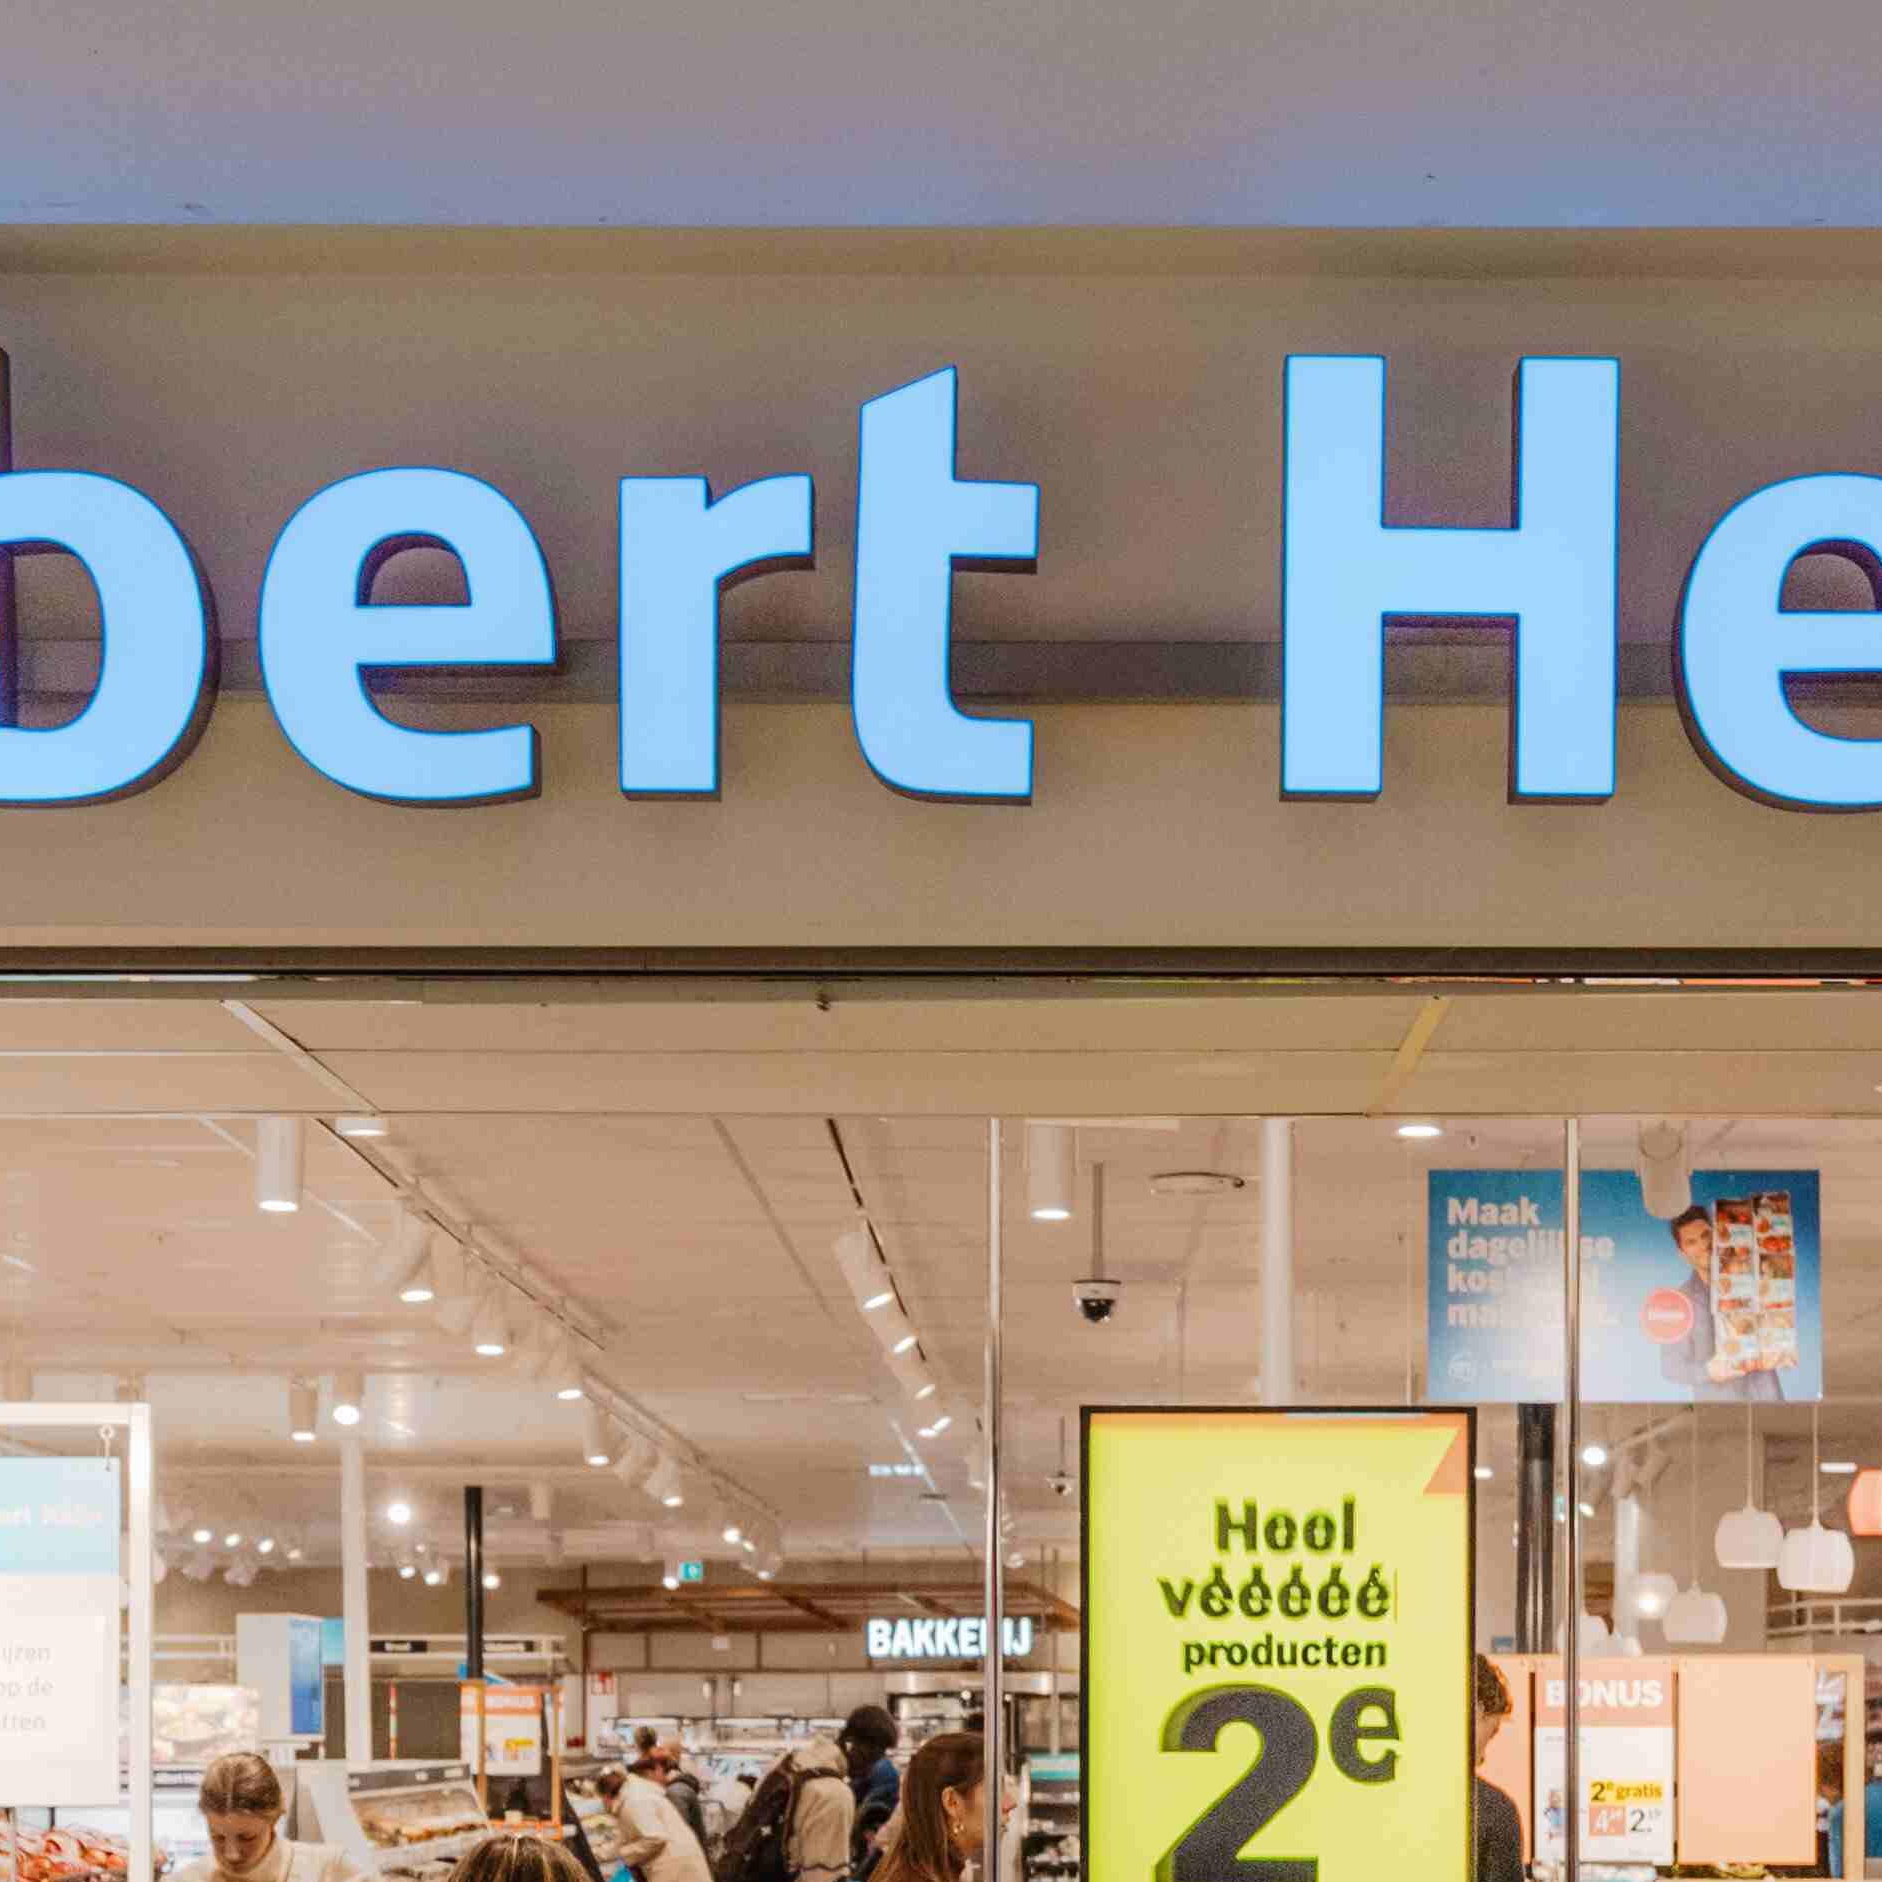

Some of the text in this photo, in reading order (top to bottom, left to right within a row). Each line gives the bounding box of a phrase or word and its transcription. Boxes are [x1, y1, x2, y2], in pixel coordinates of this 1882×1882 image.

[1447, 1196, 1541, 1226] Maak
[1447, 1229, 1615, 1263] dagelijse
[1182, 1632, 1387, 1674] producten
[27, 1675, 54, 1697] de
[1615, 1783, 1663, 1803] gratis
